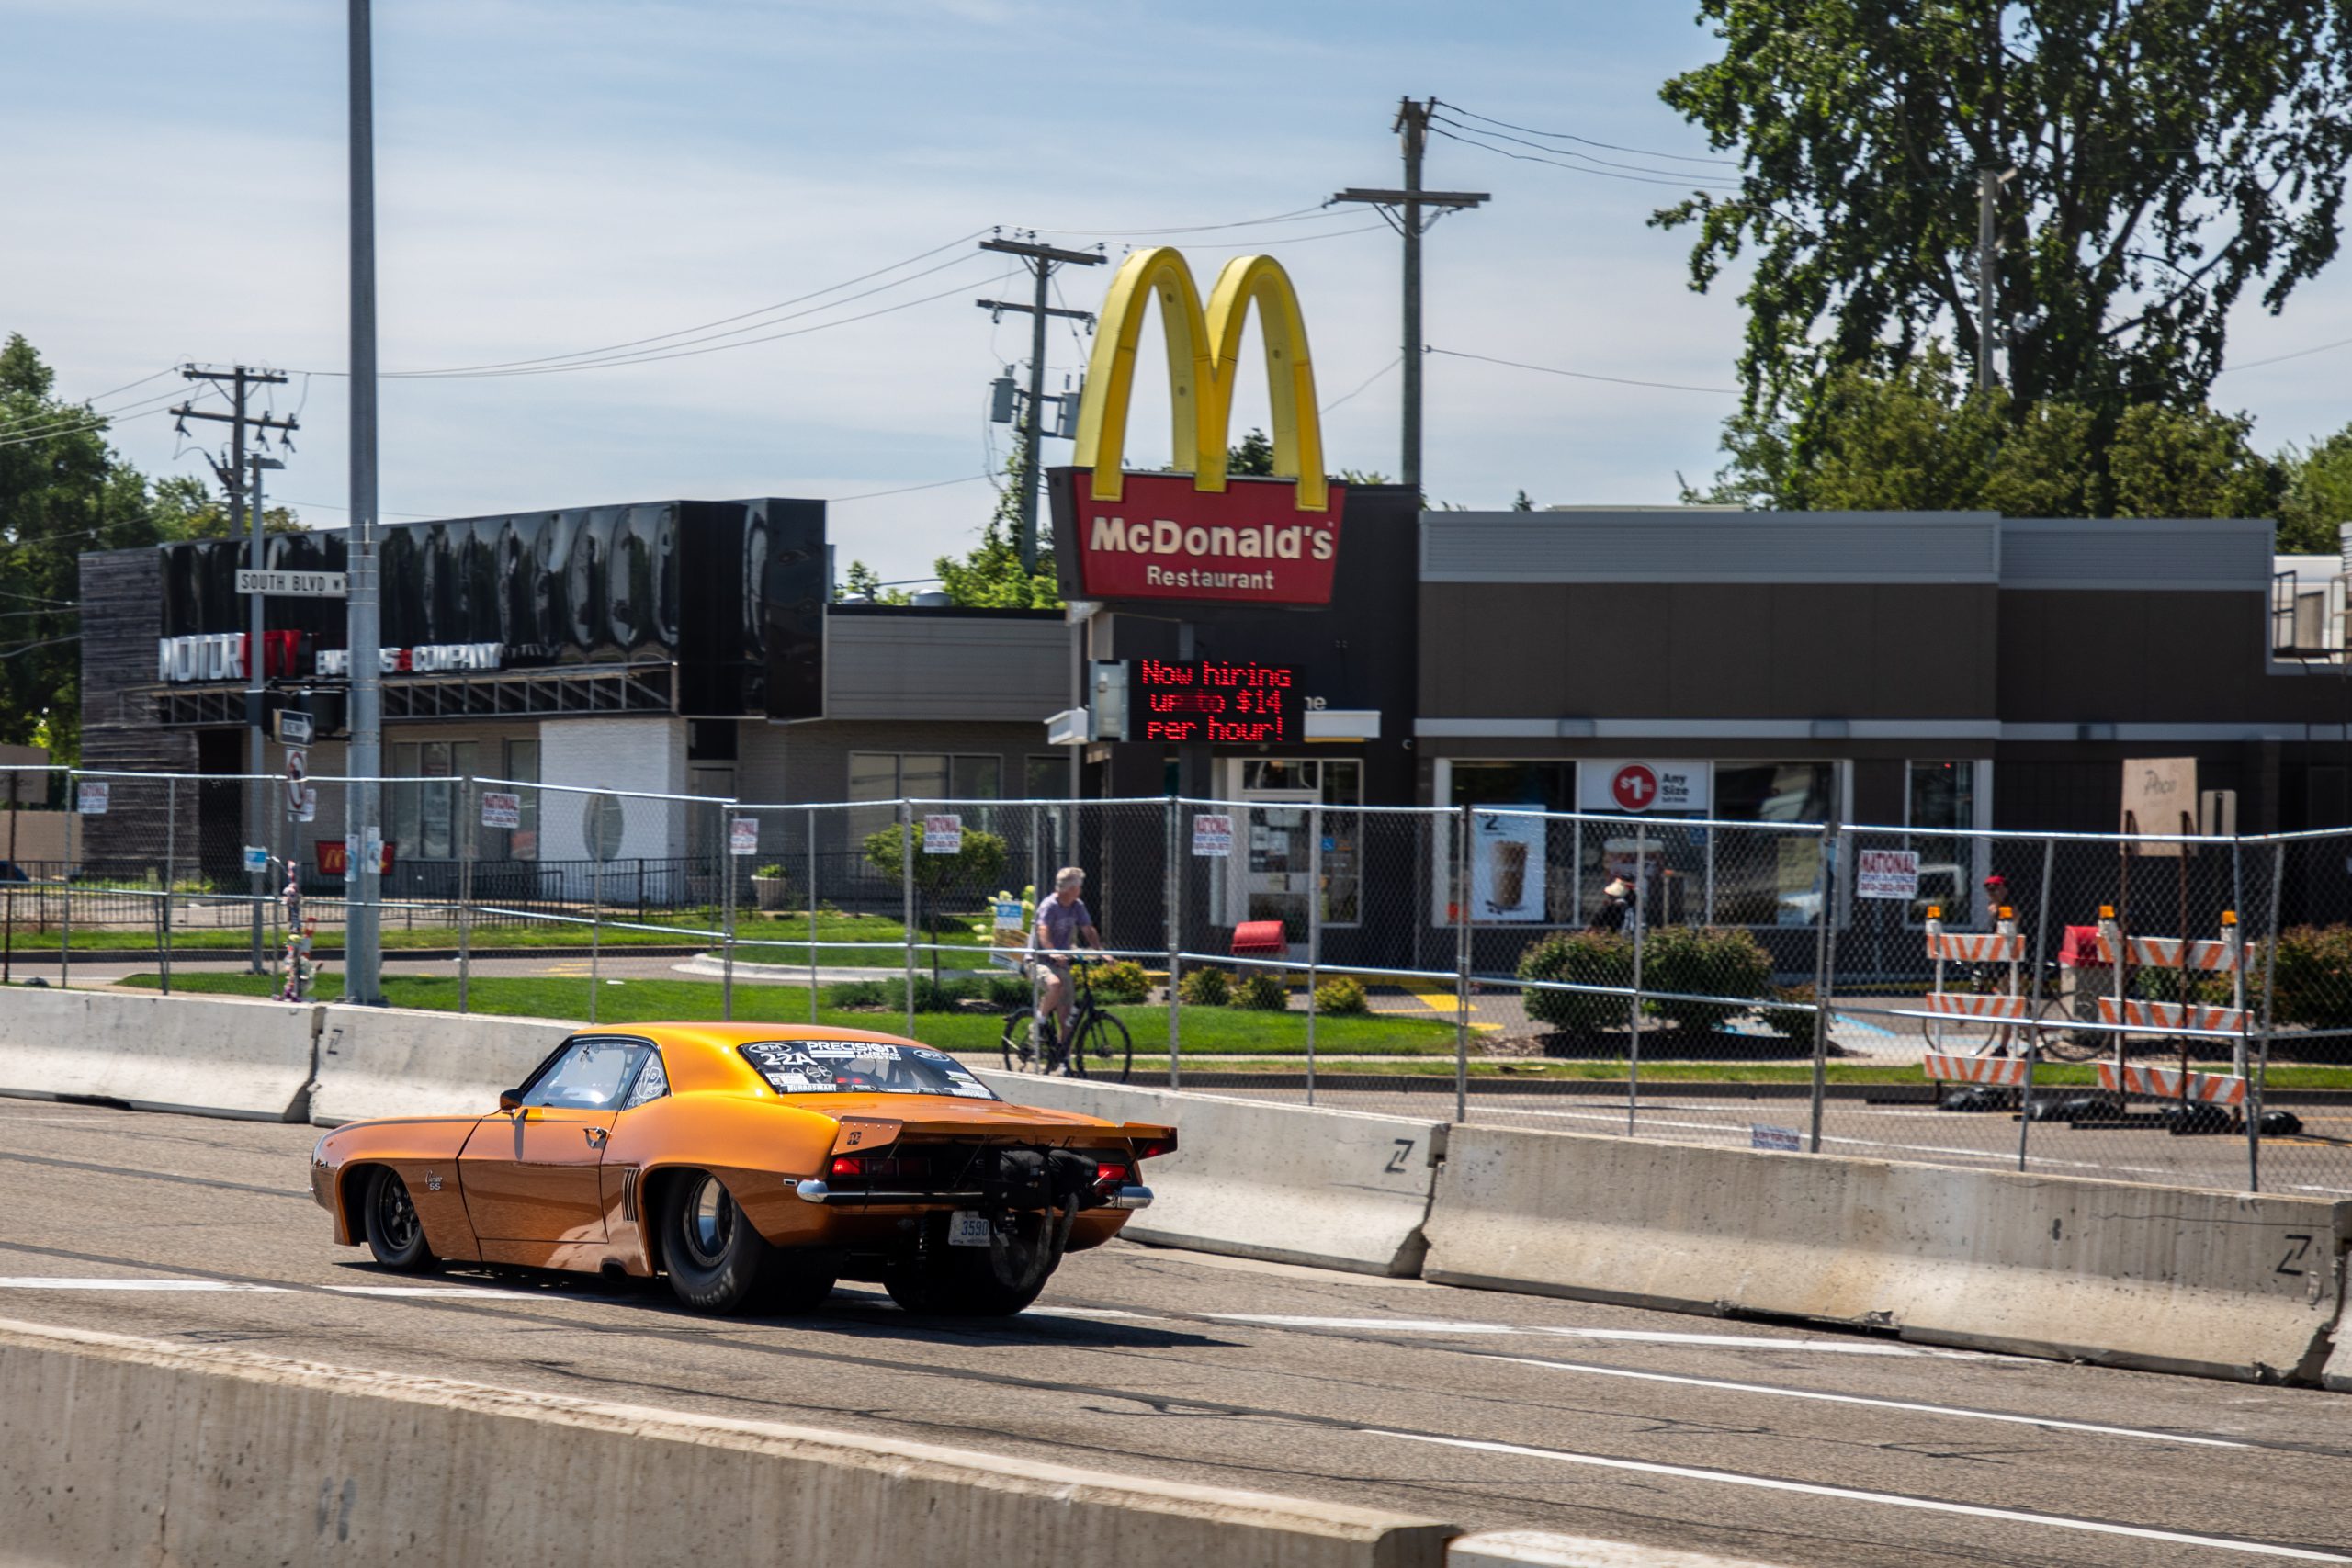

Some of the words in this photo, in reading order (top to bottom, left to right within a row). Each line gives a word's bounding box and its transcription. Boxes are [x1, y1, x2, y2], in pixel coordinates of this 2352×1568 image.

[1091, 516, 1333, 560] McDonald's
[241, 573, 286, 590] SOUTH
[292, 575, 326, 591] BLVD
[333, 579, 341, 590] W
[1147, 565, 1274, 590] Restaurant
[159, 633, 244, 682] MOTOR
[243, 629, 302, 679] CTY
[413, 642, 503, 671] COMPANY
[1142, 660, 1193, 684] Now
[1203, 661, 1291, 687] hiring
[1236, 689, 1283, 714] $14
[1148, 721, 1197, 739] per
[1208, 716, 1283, 741] hour!
[1620, 776, 1643, 800] $1
[1662, 773, 1687, 785] Any
[1662, 785, 1690, 796] Size
[1862, 853, 1917, 874] NATIONAL
[760, 1052, 819, 1066] 22A
[806, 1042, 898, 1054] PRECISION
[429, 1182, 441, 1190] SS
